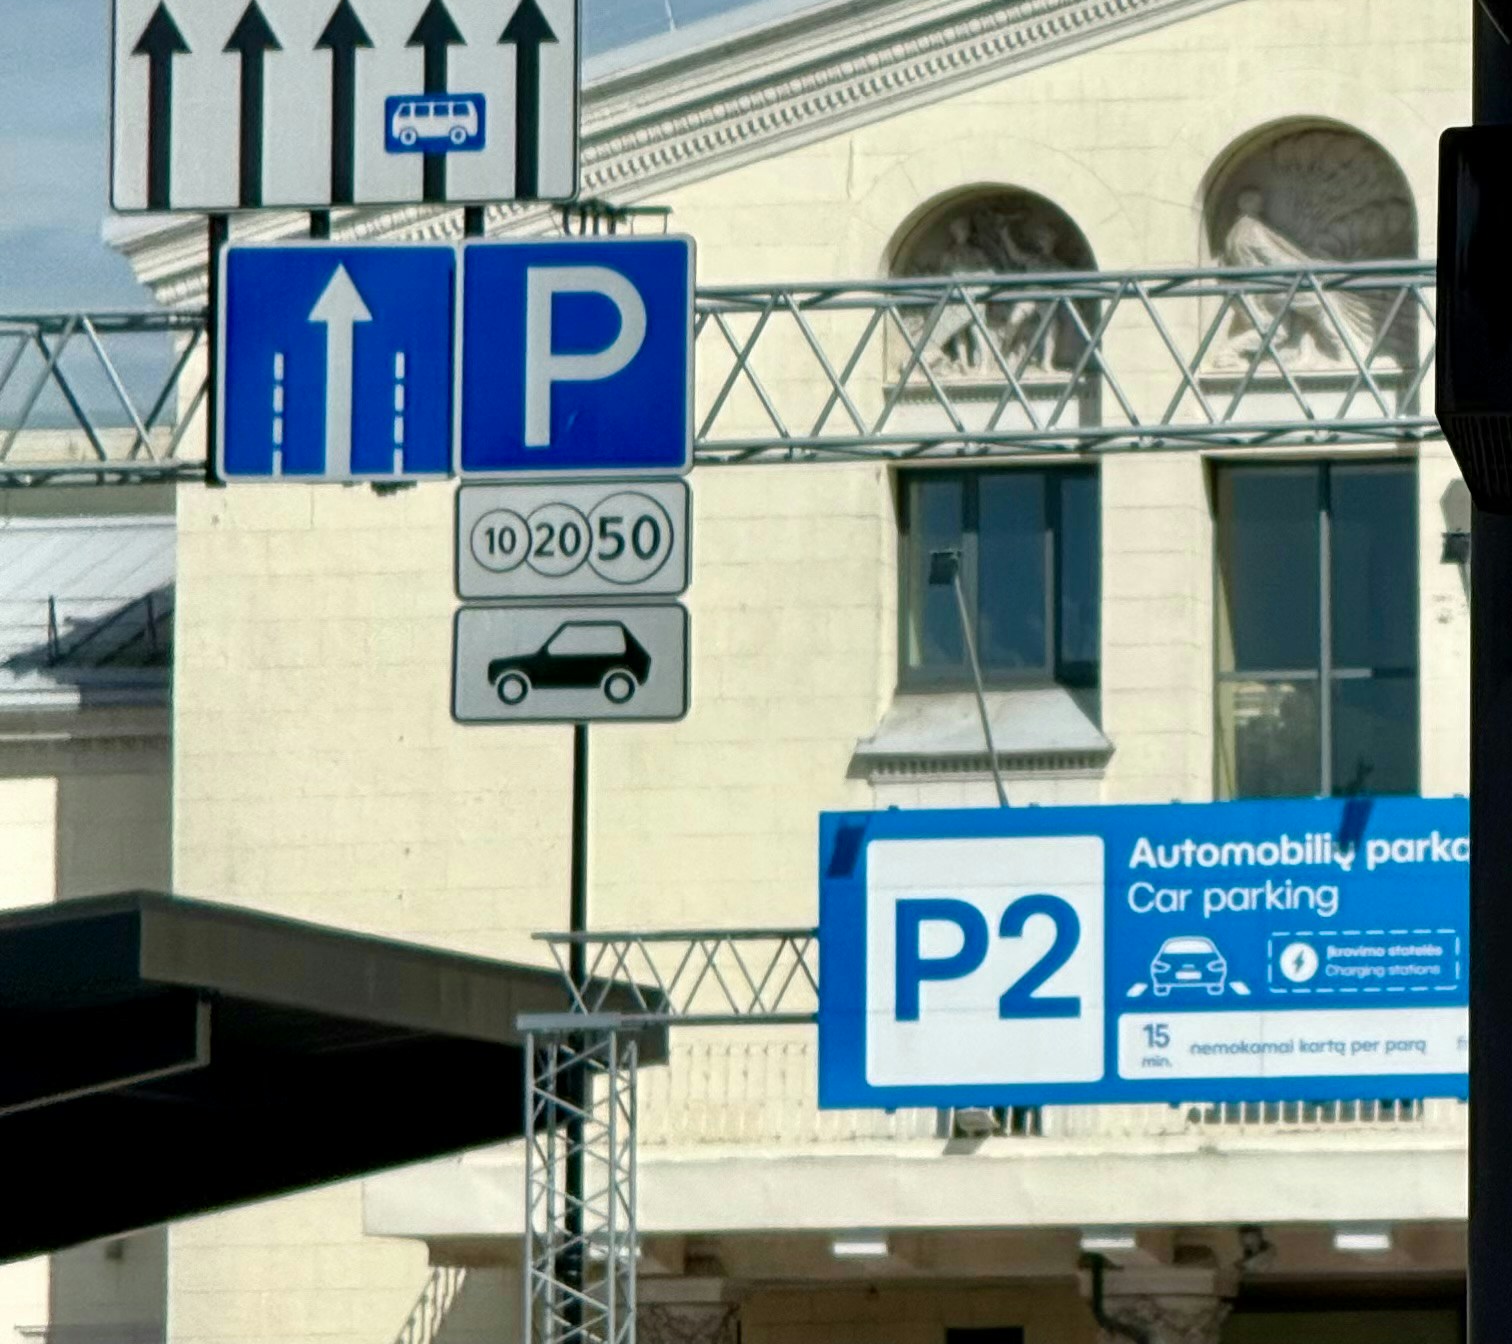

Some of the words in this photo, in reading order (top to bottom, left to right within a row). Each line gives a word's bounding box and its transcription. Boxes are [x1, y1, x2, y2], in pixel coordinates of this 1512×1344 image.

[524, 265, 647, 447] P
[485, 526, 517, 555] 10
[533, 522, 581, 557] 20
[598, 515, 661, 561] 50
[1129, 832, 1356, 872] Automobilių
[1127, 881, 1193, 914] Car
[1204, 878, 1339, 919] parking
[893, 892, 1082, 1023] P2
[1325, 964, 1386, 979] Charging
[1387, 964, 1441, 976] stations
[1142, 1023, 1171, 1048] 15
[1190, 1039, 1294, 1057] nemokamai
[1299, 1038, 1347, 1057] kartą
[1351, 1040, 1381, 1057] per
[1385, 1038, 1427, 1057] parą
[1141, 1054, 1173, 1069] min.
